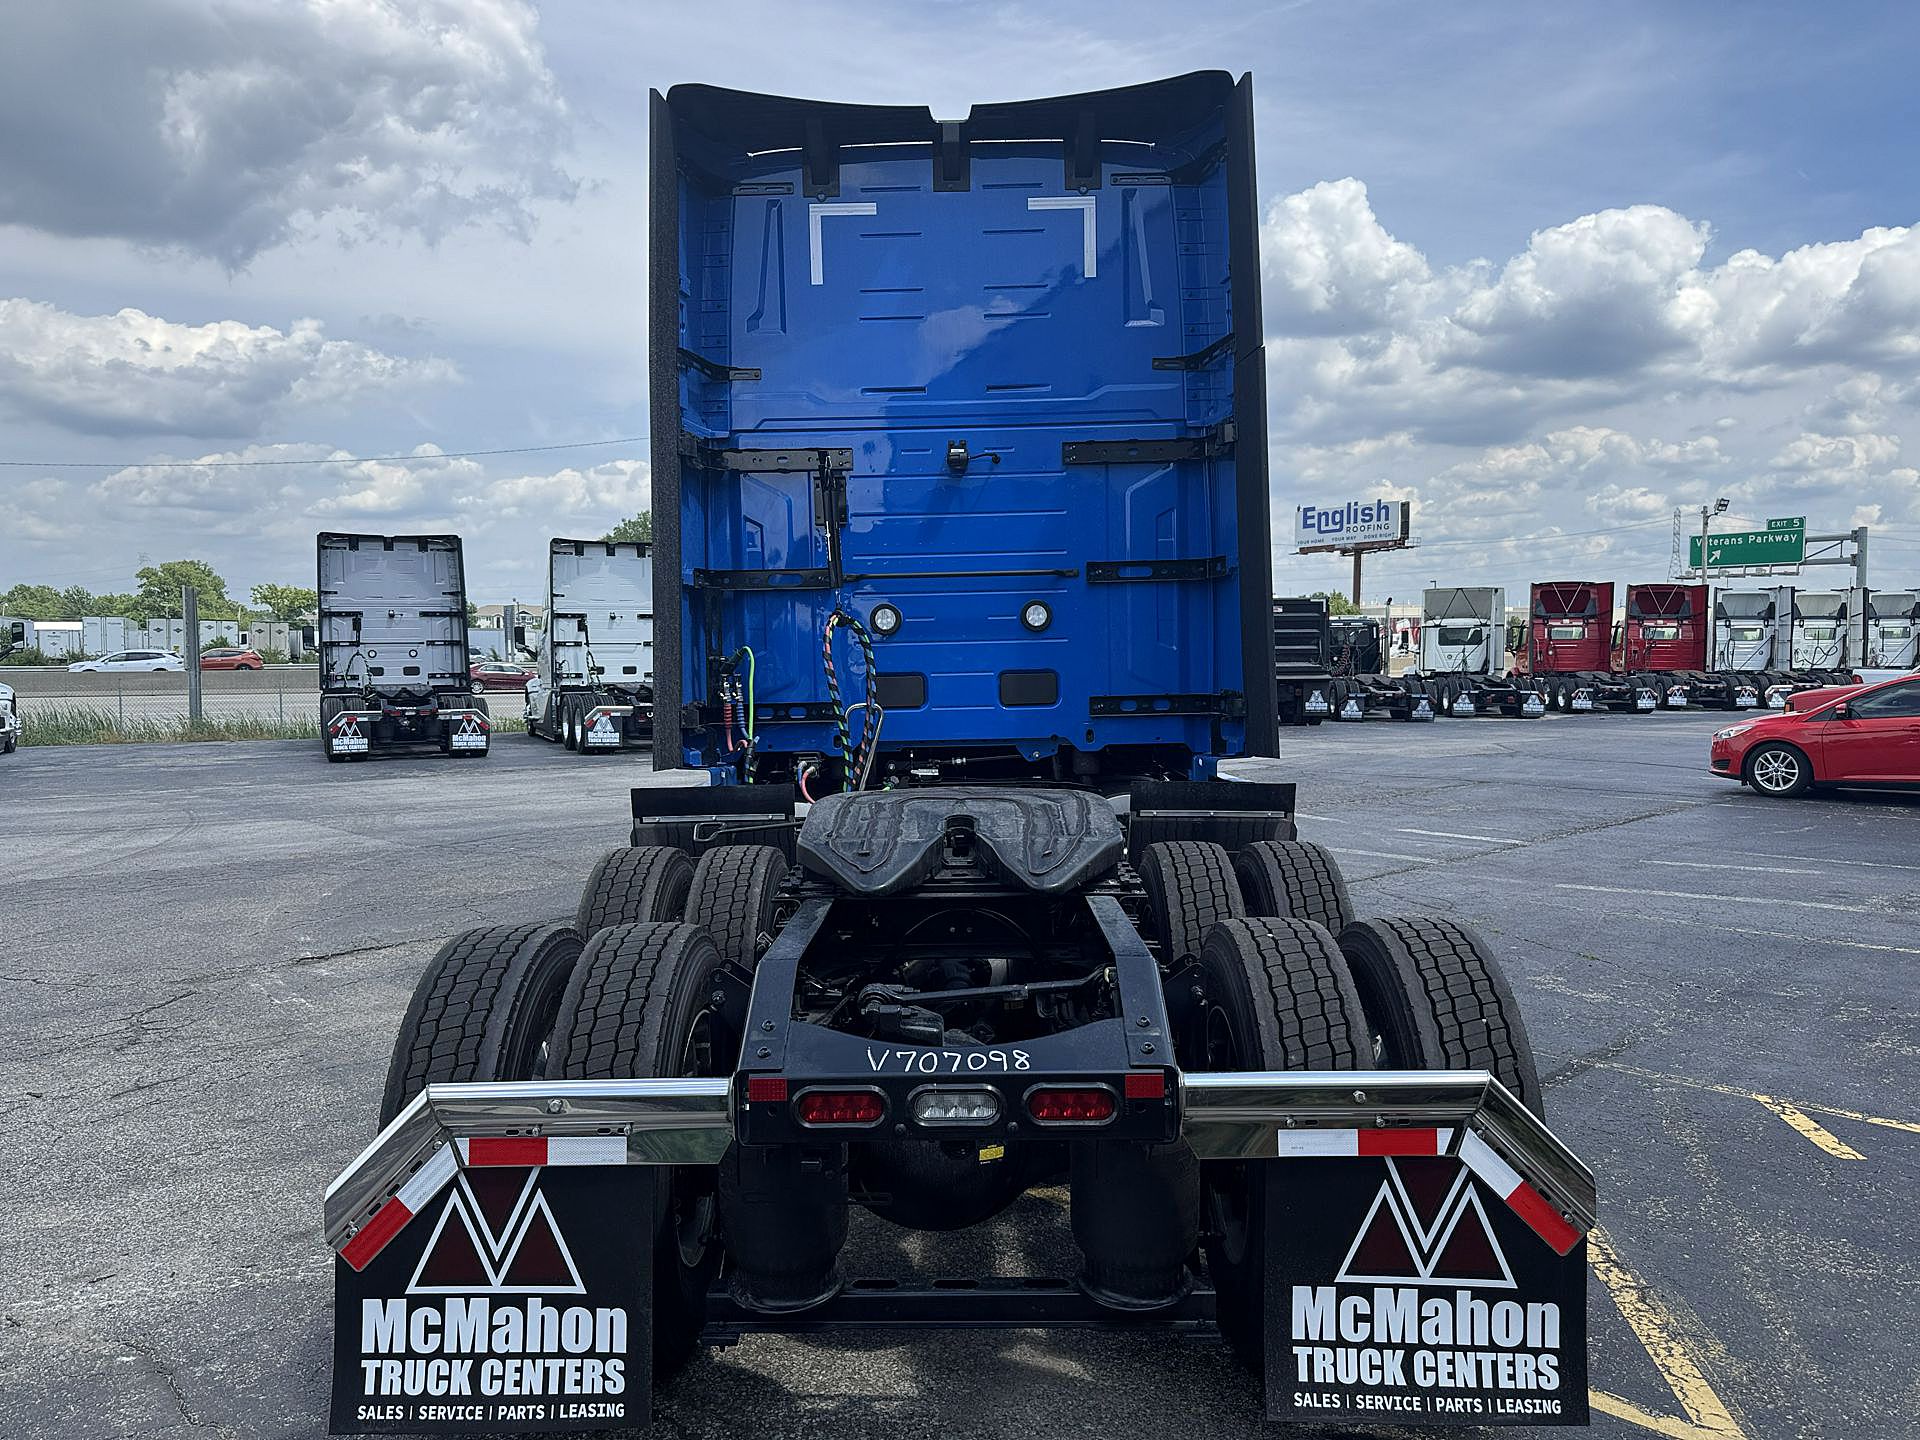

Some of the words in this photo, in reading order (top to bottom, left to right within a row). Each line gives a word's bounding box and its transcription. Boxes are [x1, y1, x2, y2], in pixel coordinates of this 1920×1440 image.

[1302, 499, 1390, 534] English
[1346, 523, 1390, 534] ROOFING
[1793, 519, 1800, 527] 5
[1696, 536, 1743, 547] Vterans
[1748, 534, 1798, 544] Parkway
[868, 1046, 1031, 1073] V707098
[361, 1297, 628, 1354] McMahon
[1291, 1286, 1561, 1349] McMahon
[361, 1359, 474, 1396] TRUCK
[480, 1358, 626, 1396] CENTERS
[1292, 1346, 1408, 1386] TRUCK
[1413, 1350, 1561, 1391] CENTERS
[357, 1405, 404, 1421] SALES
[418, 1405, 484, 1421] SERVICE
[498, 1404, 546, 1420] PARTS
[559, 1403, 625, 1419] LEASING
[1293, 1392, 1341, 1409] SALES
[1355, 1394, 1422, 1412] SERVICE
[1436, 1396, 1483, 1413] PARTS
[1497, 1398, 1562, 1415] LEASING
